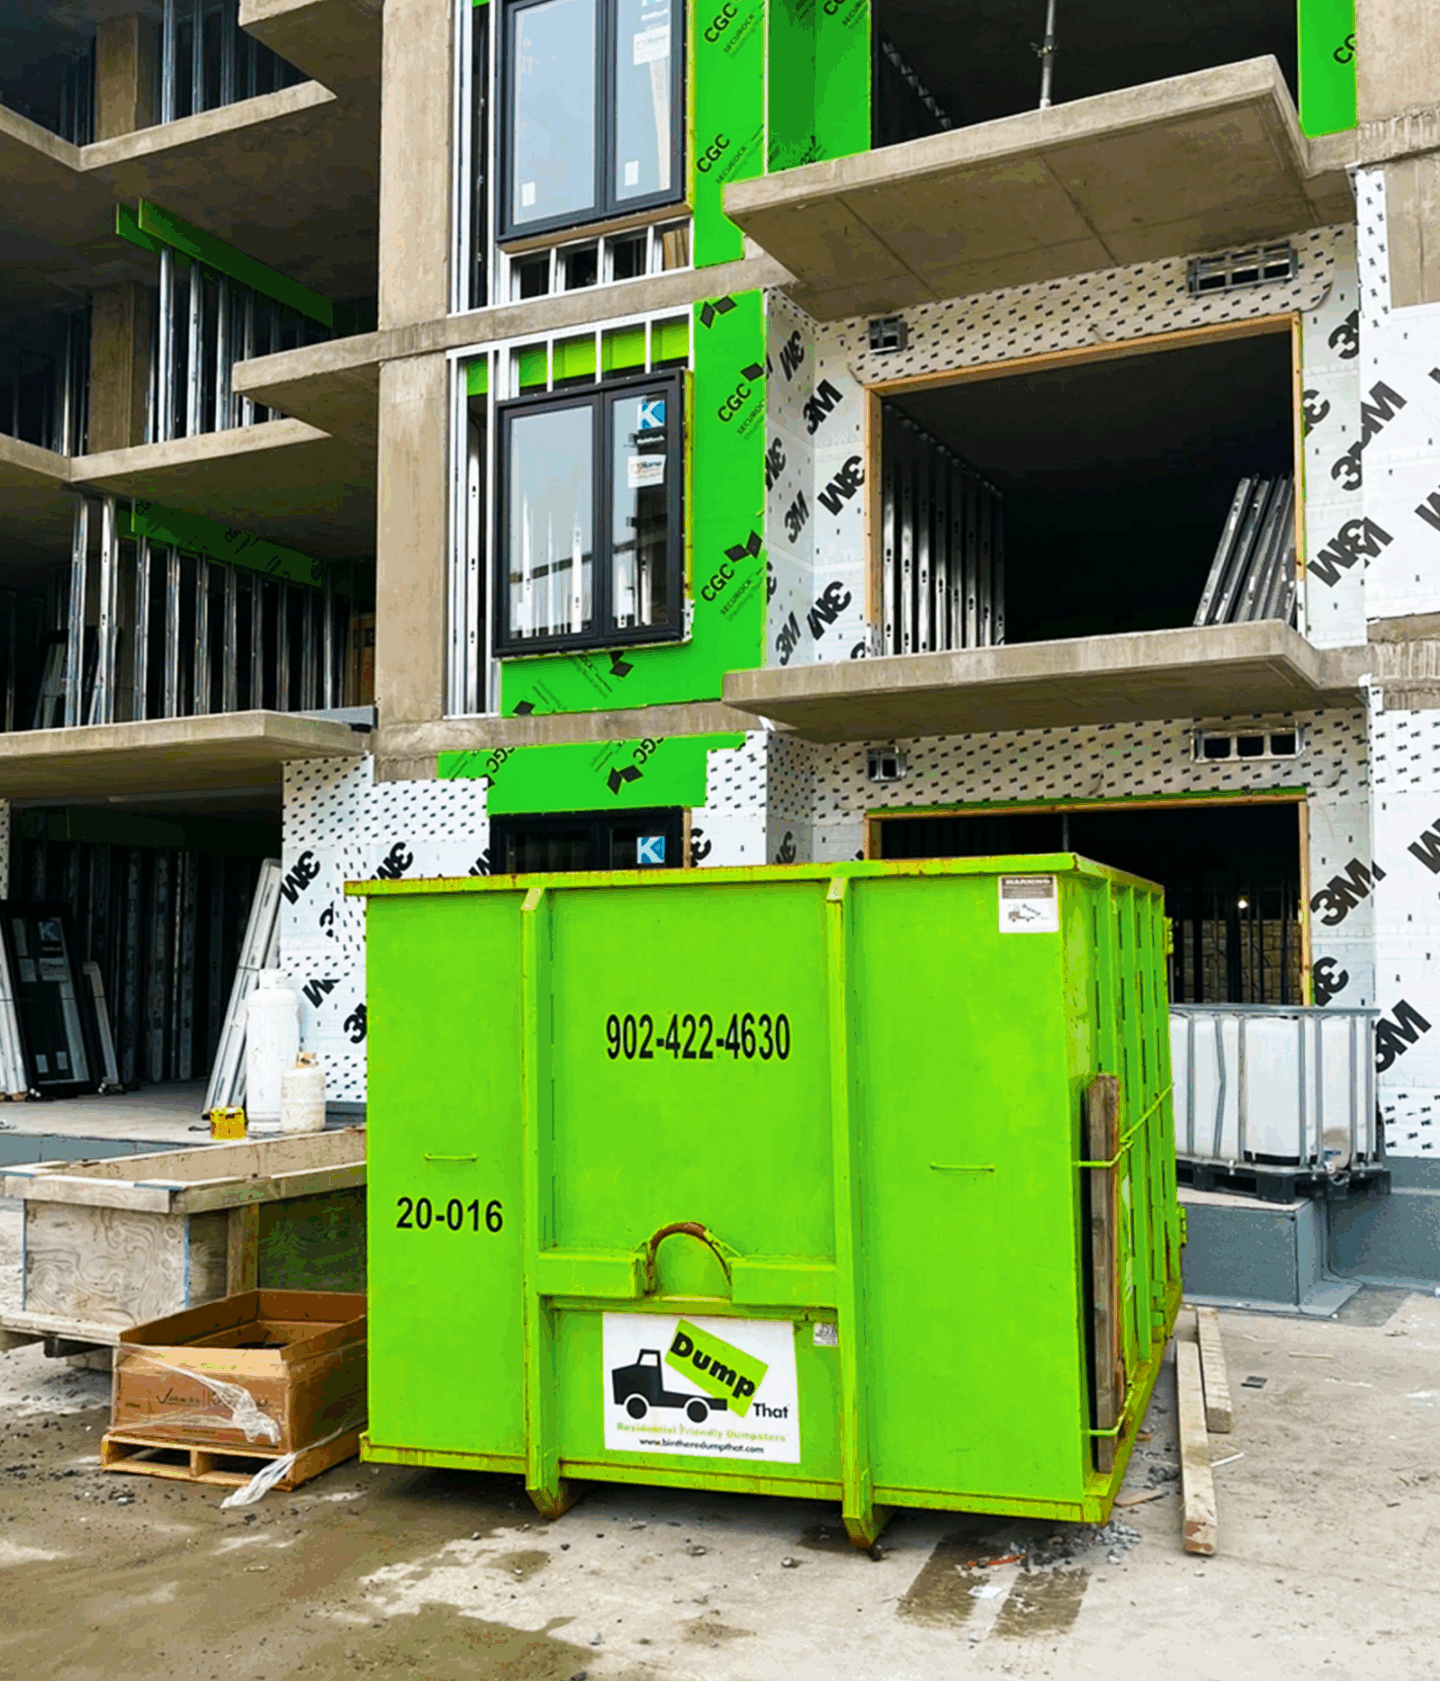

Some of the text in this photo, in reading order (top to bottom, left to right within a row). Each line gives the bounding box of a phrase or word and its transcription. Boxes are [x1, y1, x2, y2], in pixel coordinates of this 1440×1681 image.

[704, 3, 738, 43] CGC
[696, 133, 730, 173] CGC
[717, 383, 751, 422] CGC
[803, 379, 843, 435] 3M
[817, 455, 865, 516] 3M
[784, 490, 810, 544] 3M
[701, 563, 735, 602] CGC
[775, 610, 801, 666] 3M
[807, 581, 852, 641] 3M
[281, 850, 321, 905] 3M
[1310, 857, 1386, 927] 3M
[606, 1013, 791, 1060] 902-422-4630
[396, 1197, 503, 1232] 20-016
[669, 1330, 756, 1399] Dump
[752, 1403, 788, 1419] That
